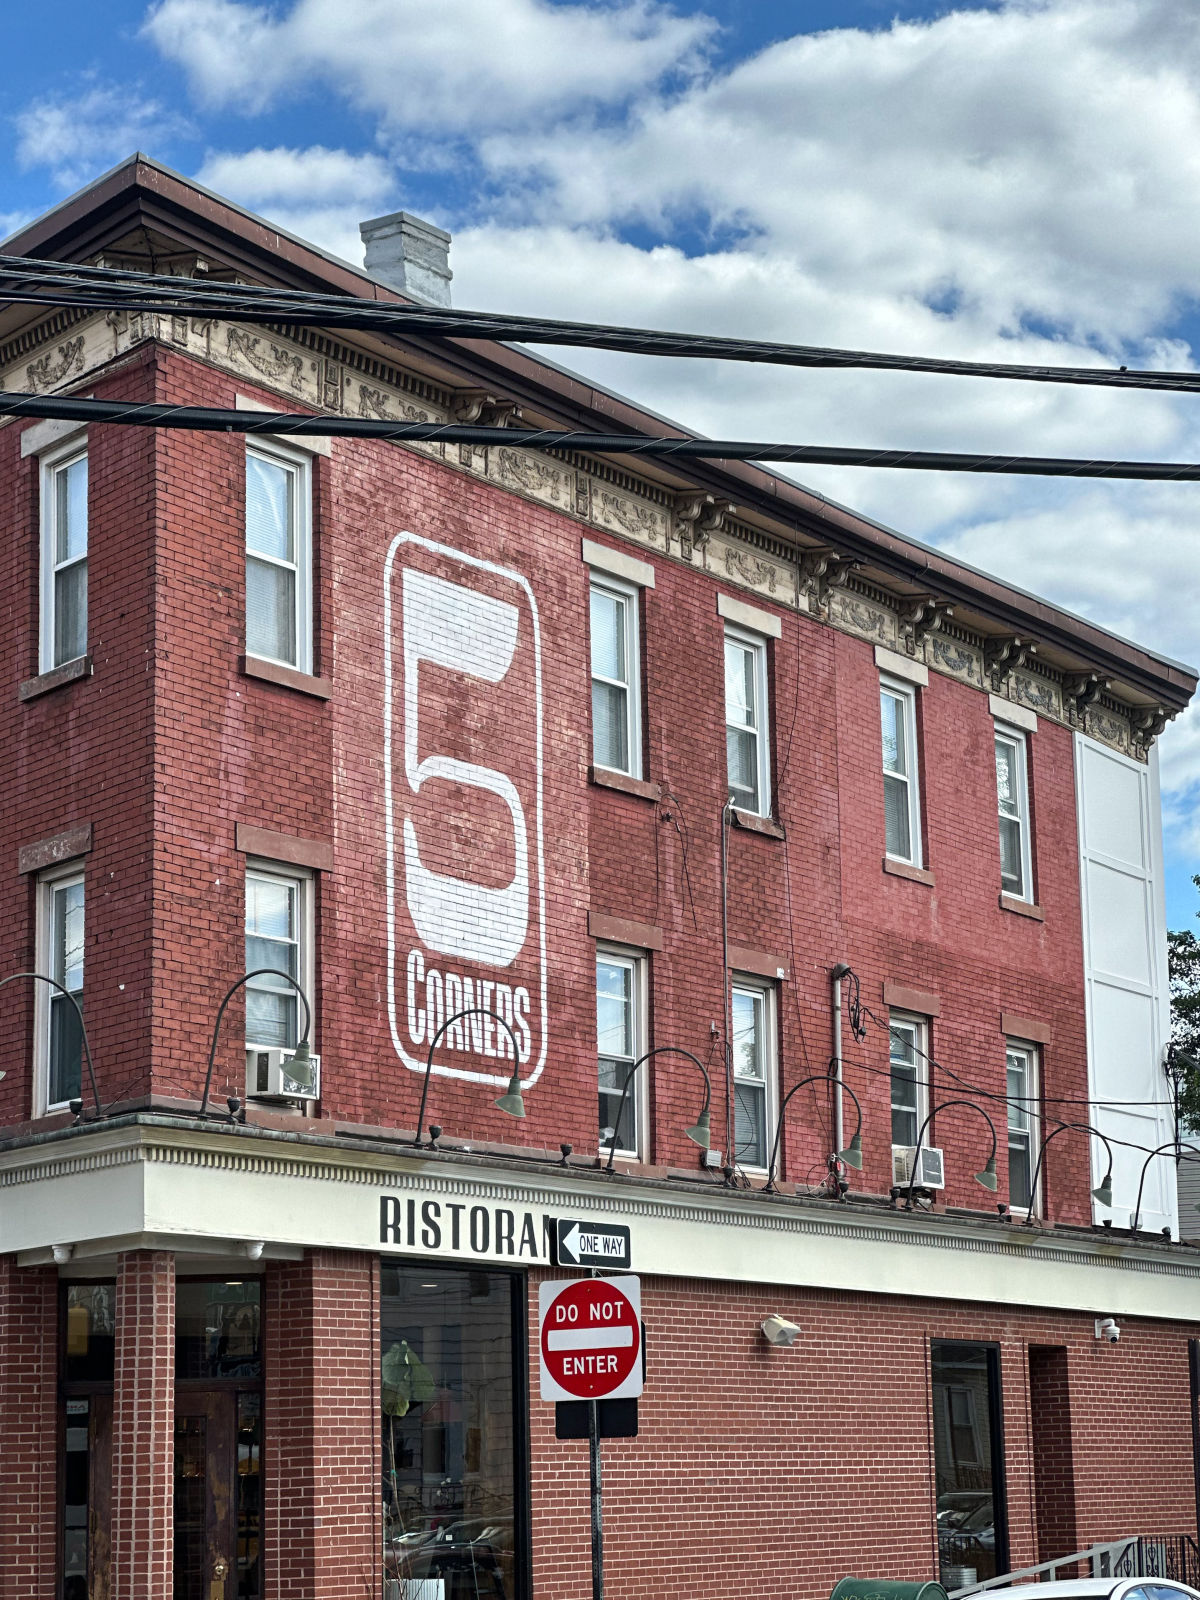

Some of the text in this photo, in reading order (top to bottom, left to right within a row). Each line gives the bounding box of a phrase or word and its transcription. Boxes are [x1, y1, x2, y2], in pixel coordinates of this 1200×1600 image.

[402, 567, 528, 967] 5
[407, 949, 531, 1063] CORNERS
[579, 1234, 623, 1255] ONE WAY
[556, 1301, 624, 1323] DO NOT
[563, 1355, 618, 1375] ENTER
